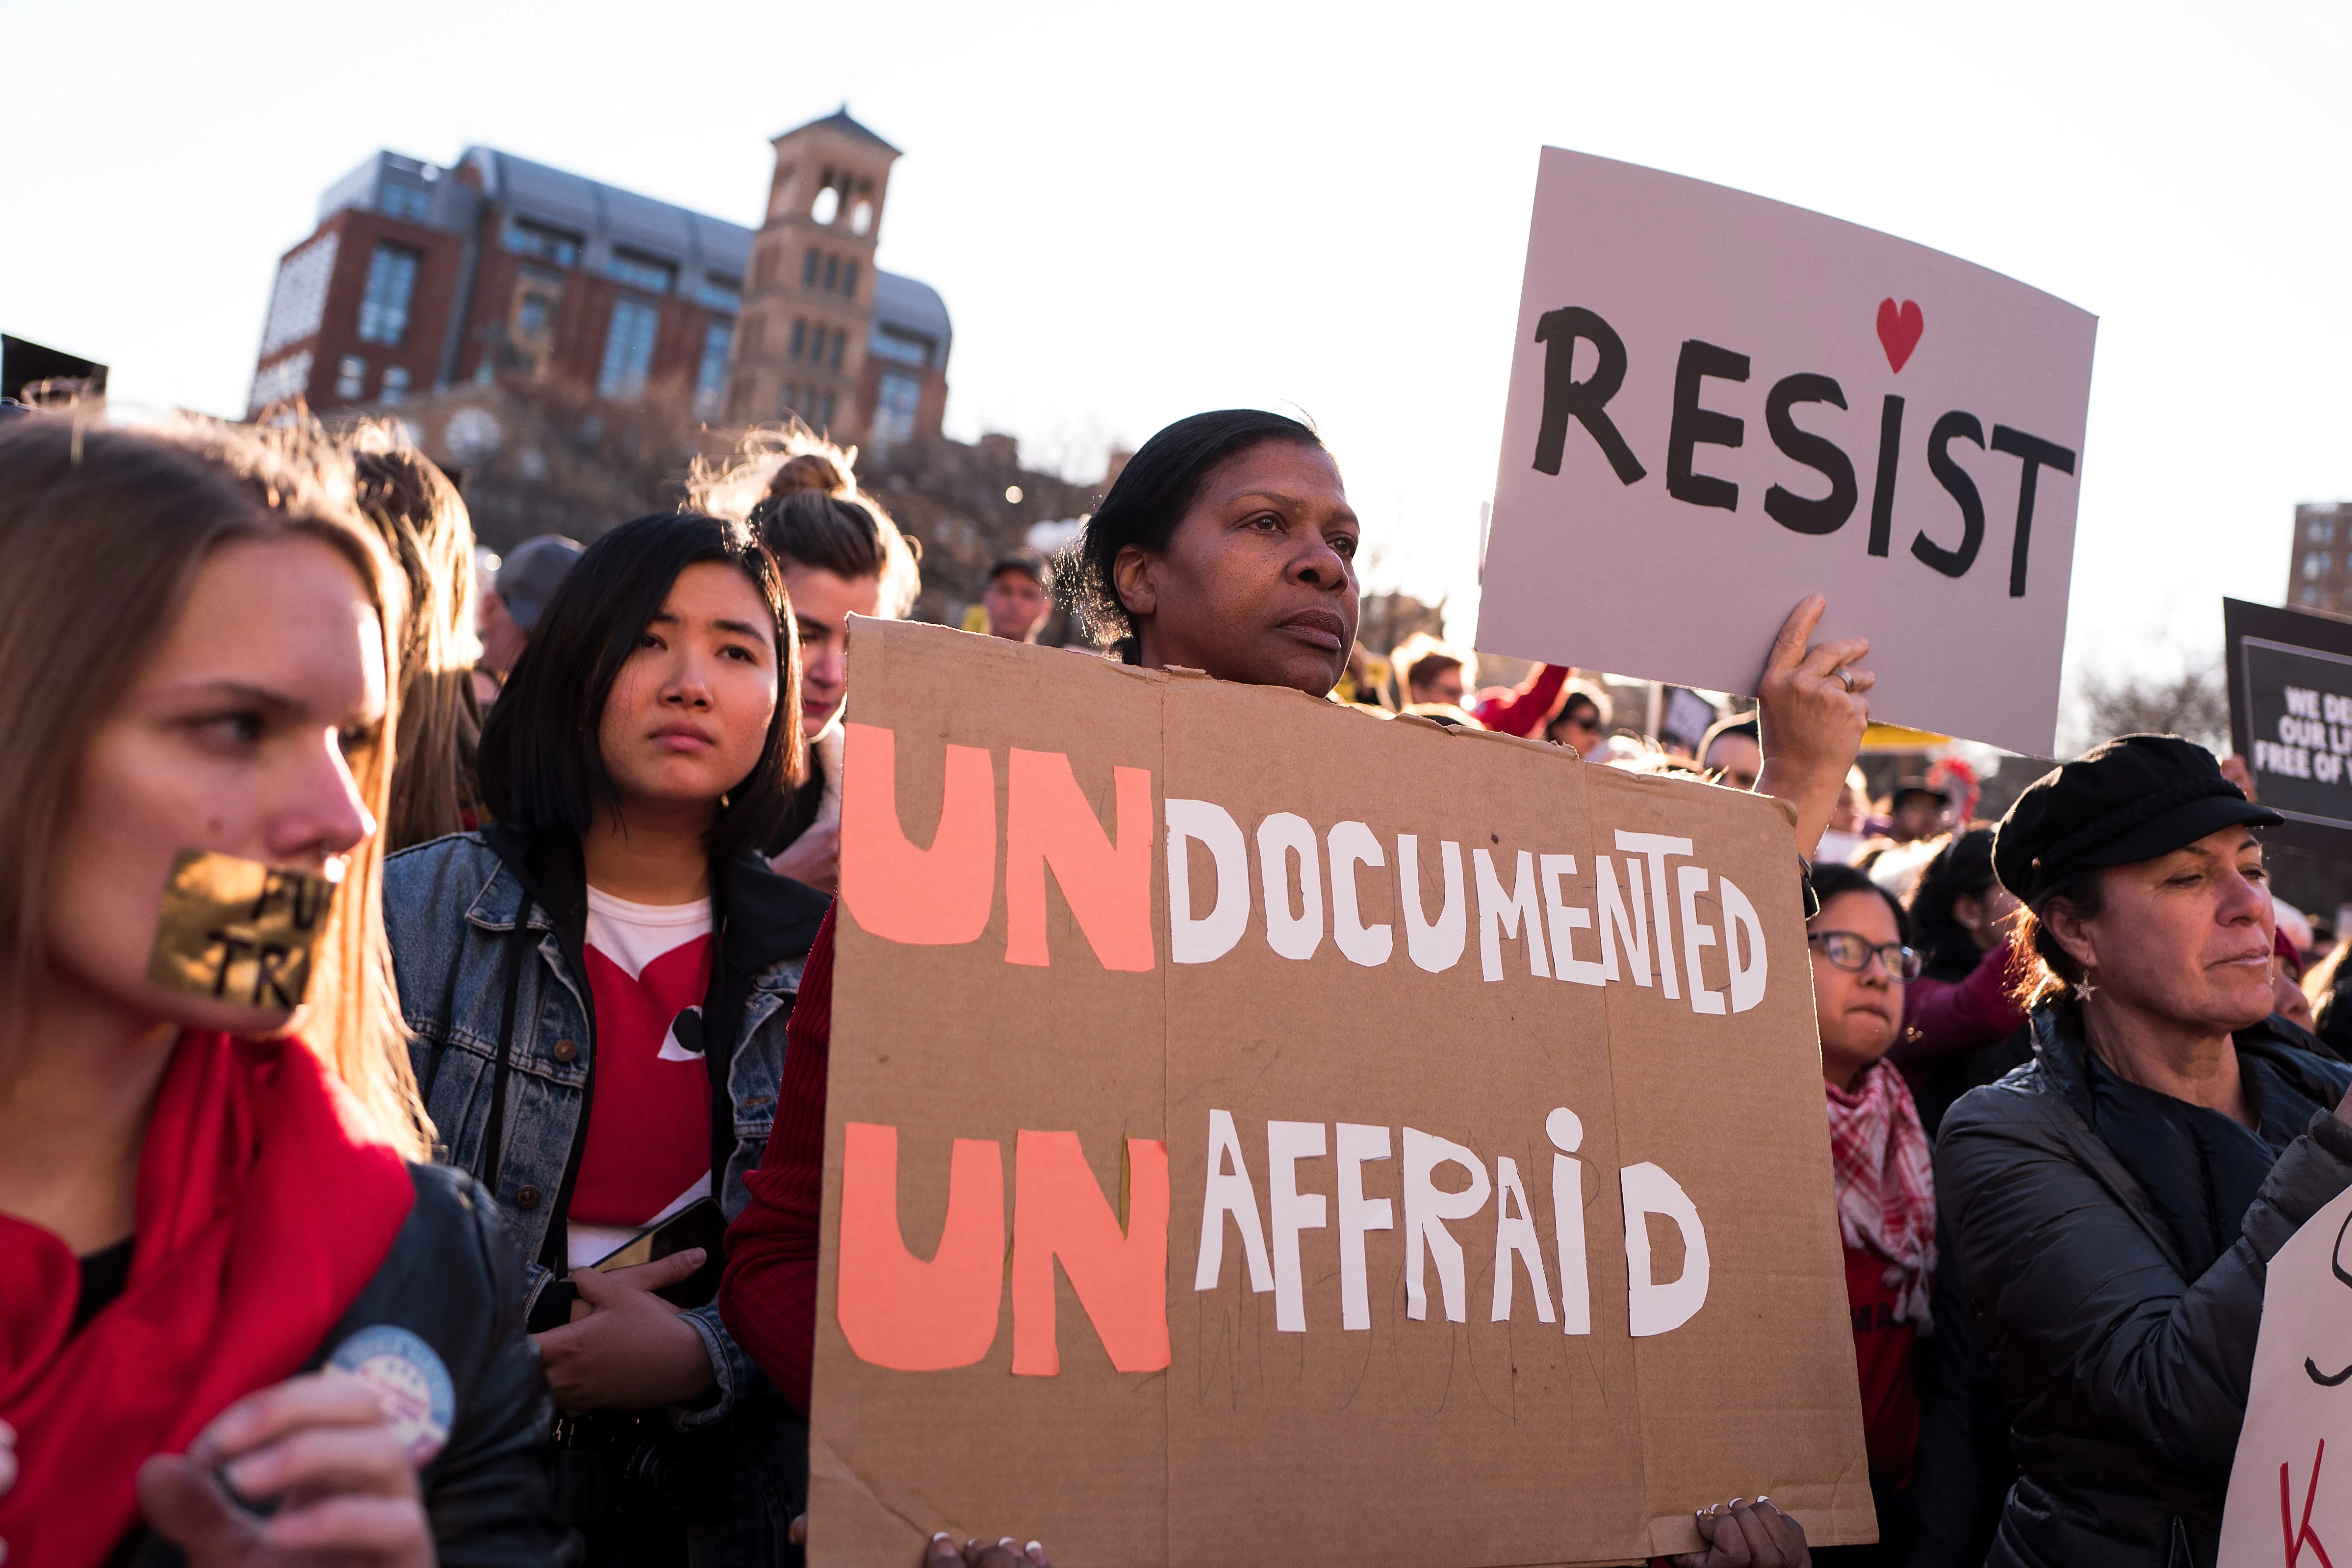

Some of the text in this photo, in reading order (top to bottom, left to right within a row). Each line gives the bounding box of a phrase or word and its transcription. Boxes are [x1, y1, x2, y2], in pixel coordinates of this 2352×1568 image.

[1531, 305, 2076, 597] RESIST
[2283, 685, 2321, 720] WE
[2278, 714, 2327, 750] OUR
[2254, 739, 2312, 780] FREE
[2313, 751, 2343, 785] OF
[840, 722, 1767, 1015] UNDOCUMENTED
